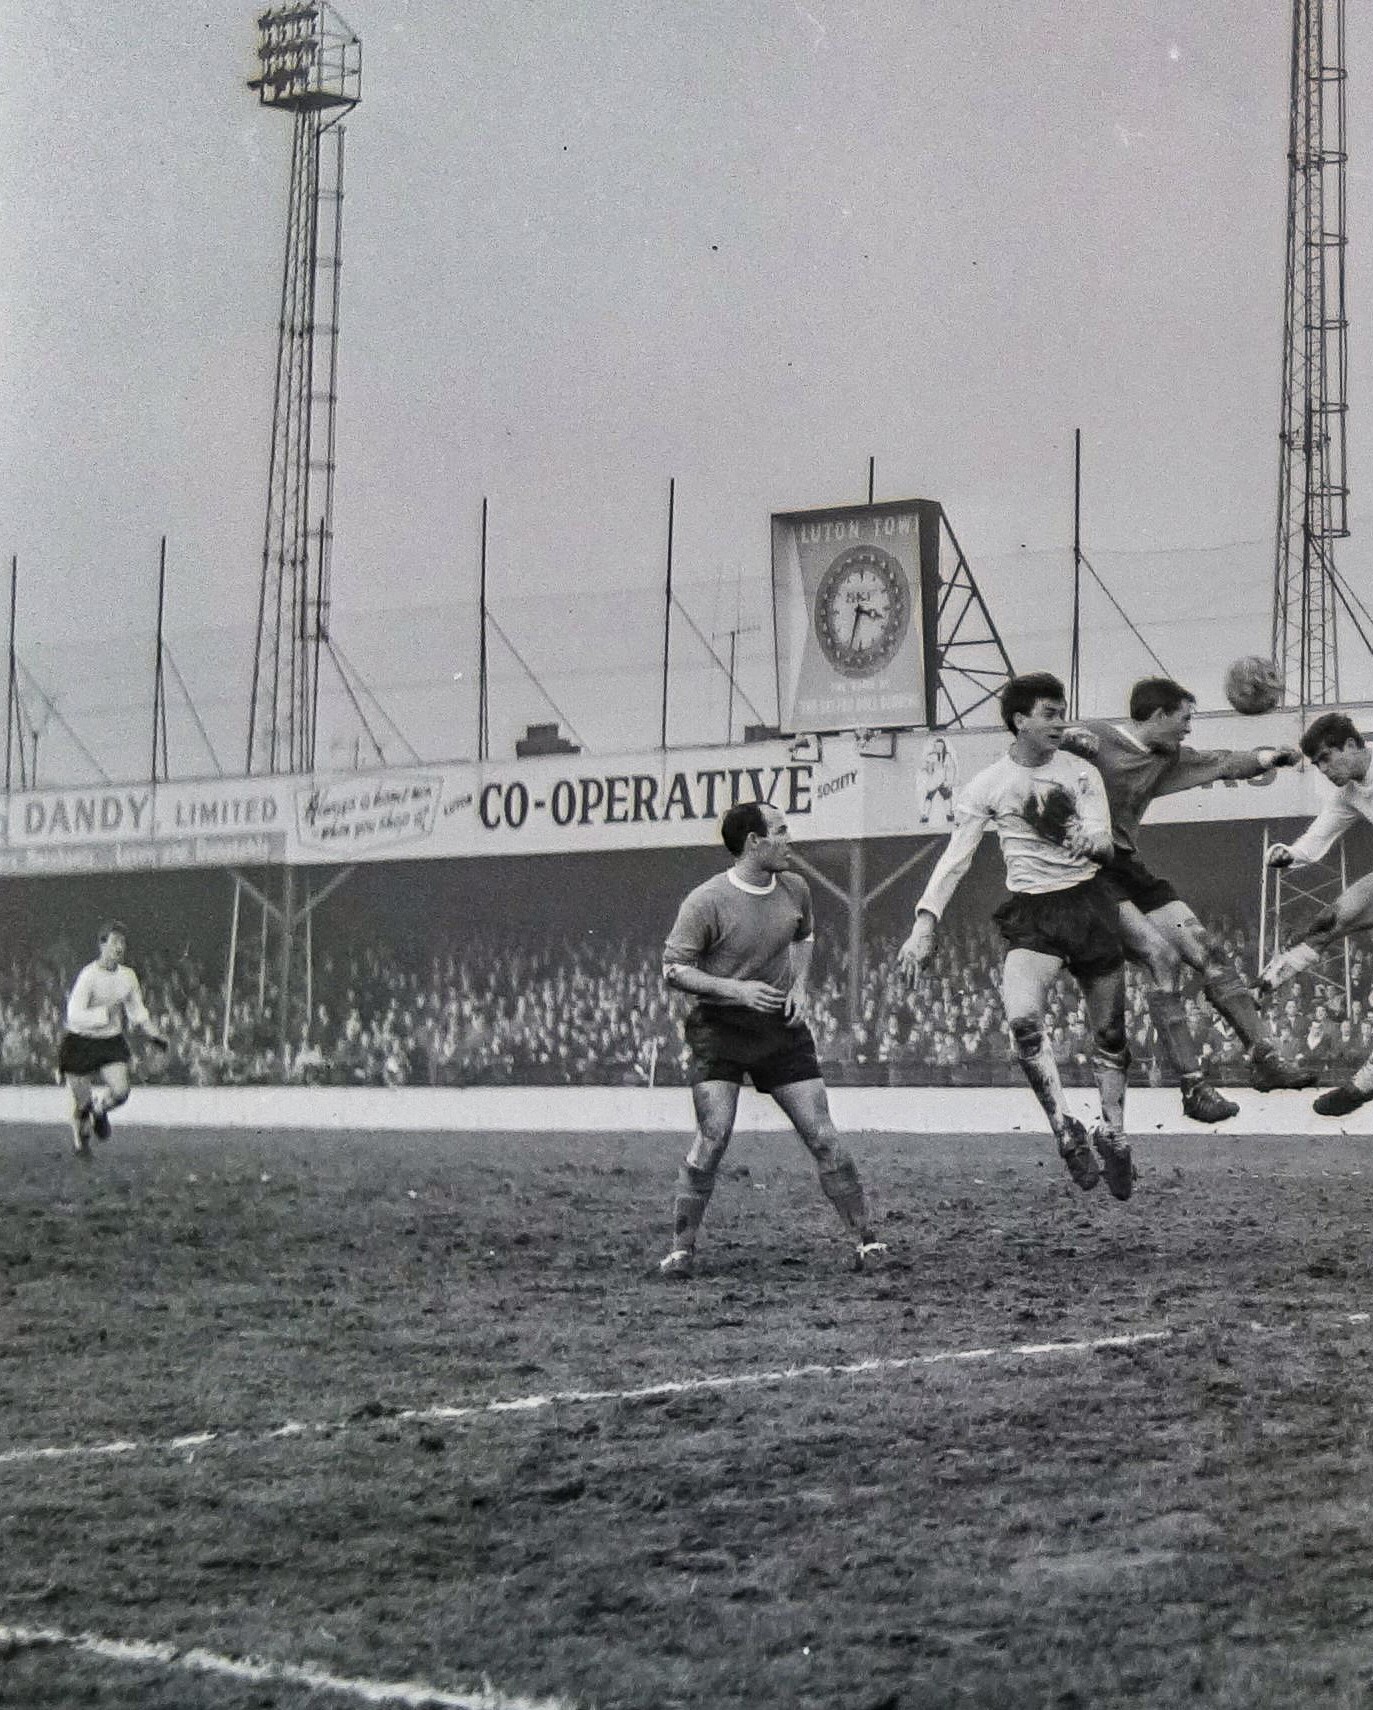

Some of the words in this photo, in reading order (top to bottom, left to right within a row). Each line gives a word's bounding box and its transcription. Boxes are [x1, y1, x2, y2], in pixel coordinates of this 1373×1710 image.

[801, 519, 859, 543] LUTON
[25, 794, 149, 834] DANDY
[176, 798, 277, 826] LIMITED
[479, 765, 814, 830] CO-OPERATIVE
[817, 769, 858, 799] SOCIETY
